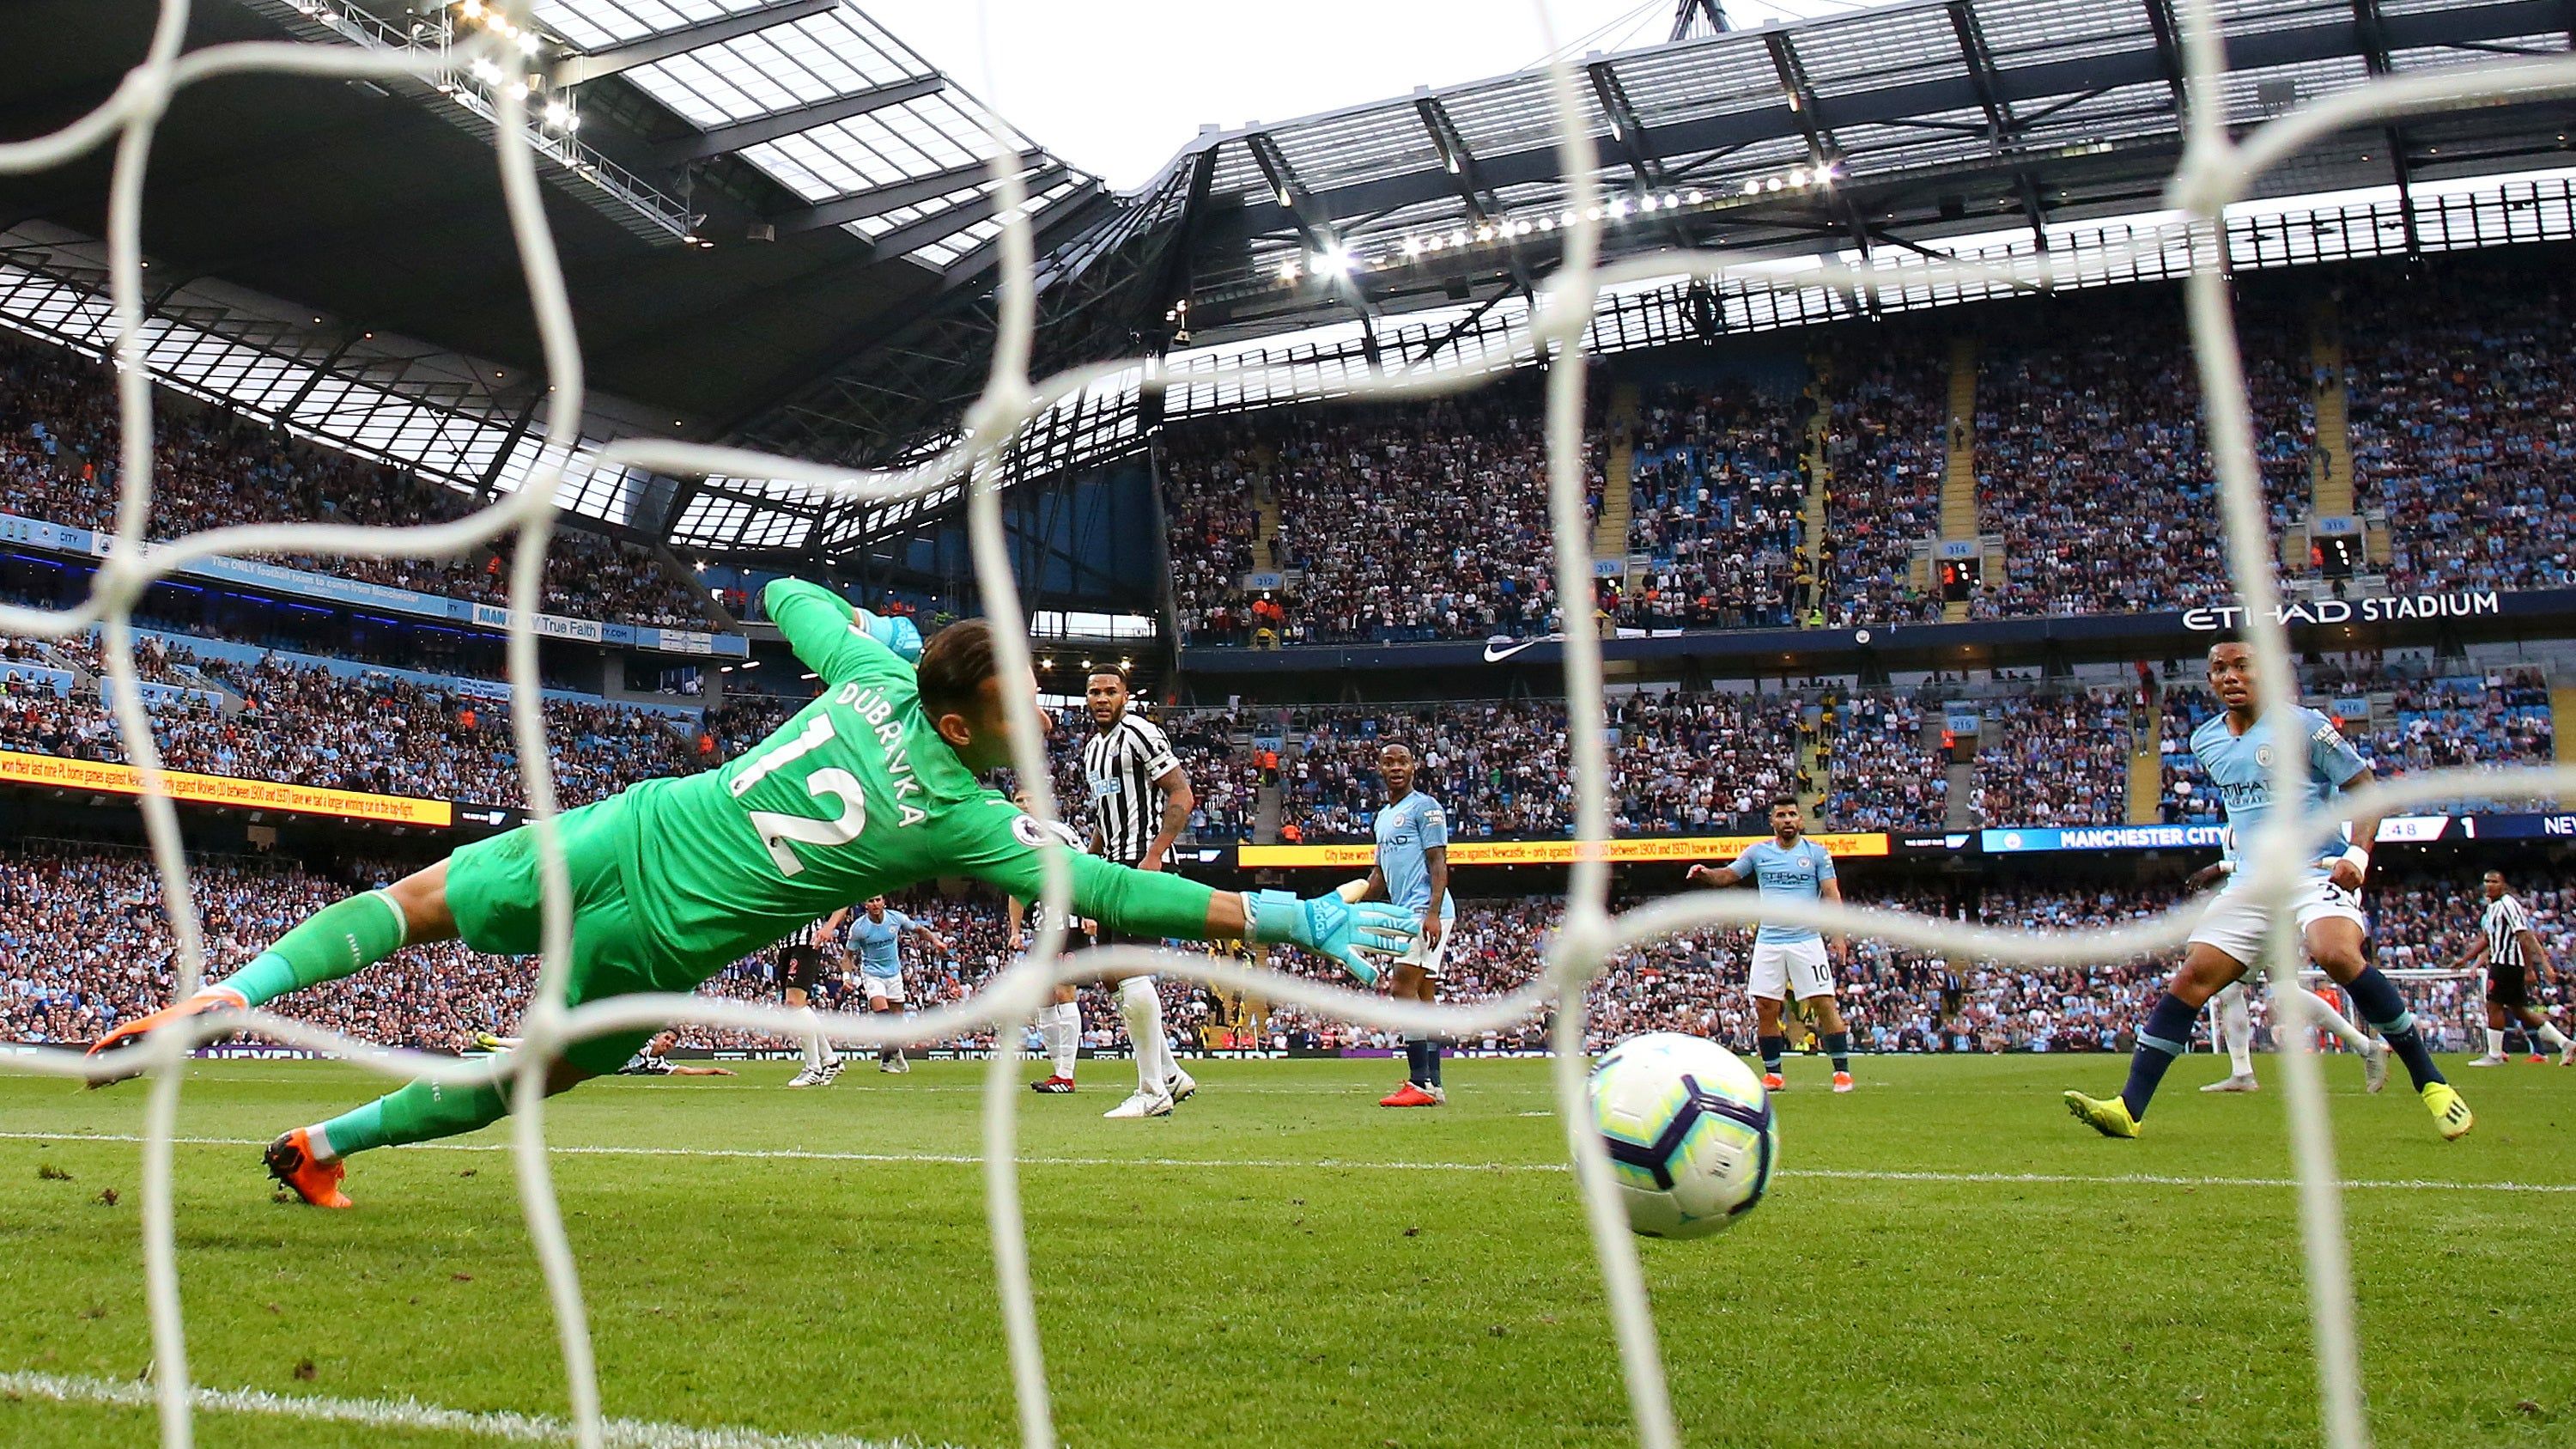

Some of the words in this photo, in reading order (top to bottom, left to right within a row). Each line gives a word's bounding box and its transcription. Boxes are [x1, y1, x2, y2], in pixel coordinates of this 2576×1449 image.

[60, 532, 78, 544] CITY
[212, 555, 229, 568] The
[231, 559, 255, 574] ONLY
[257, 564, 290, 580] football
[315, 575, 325, 587] to
[372, 583, 419, 603] Manchester
[478, 606, 507, 626] MAN
[542, 617, 568, 634] True
[570, 621, 597, 638] Faith
[2362, 591, 2500, 622] STADIUM
[834, 681, 927, 828] DÚBRAVKA
[2, 760, 15, 772] won
[15, 758, 30, 774] their
[32, 759, 43, 776] last
[68, 764, 83, 781] home
[84, 770, 104, 785] games
[105, 770, 127, 788] against
[176, 777, 197, 795] against
[197, 779, 216, 795] Wolves
[227, 782, 250, 799] between
[292, 789, 304, 805] have
[313, 792, 323, 807] had
[345, 795, 365, 814] winning
[728, 710, 867, 879] 12
[2061, 828, 2184, 848] MANCHESTER
[2186, 826, 2227, 845] CITY
[2460, 816, 2475, 839] 1
[2544, 816, 2576, 835] NE
[1325, 849, 1338, 863] City
[1339, 849, 1356, 861] have
[1356, 850, 1369, 861] won
[1467, 846, 1491, 861] against
[1492, 846, 1526, 858] Newcastle
[1533, 846, 1546, 860] only
[1548, 845, 1573, 860] against
[1610, 844, 1638, 855] between
[1639, 843, 1657, 855] 1900
[1658, 843, 1670, 855] and
[1672, 842, 1691, 856] 1937)
[1692, 842, 1709, 854] have
[1709, 845, 1718, 854] we
[1719, 841, 1732, 854] had
[1811, 964, 1830, 983] 10
